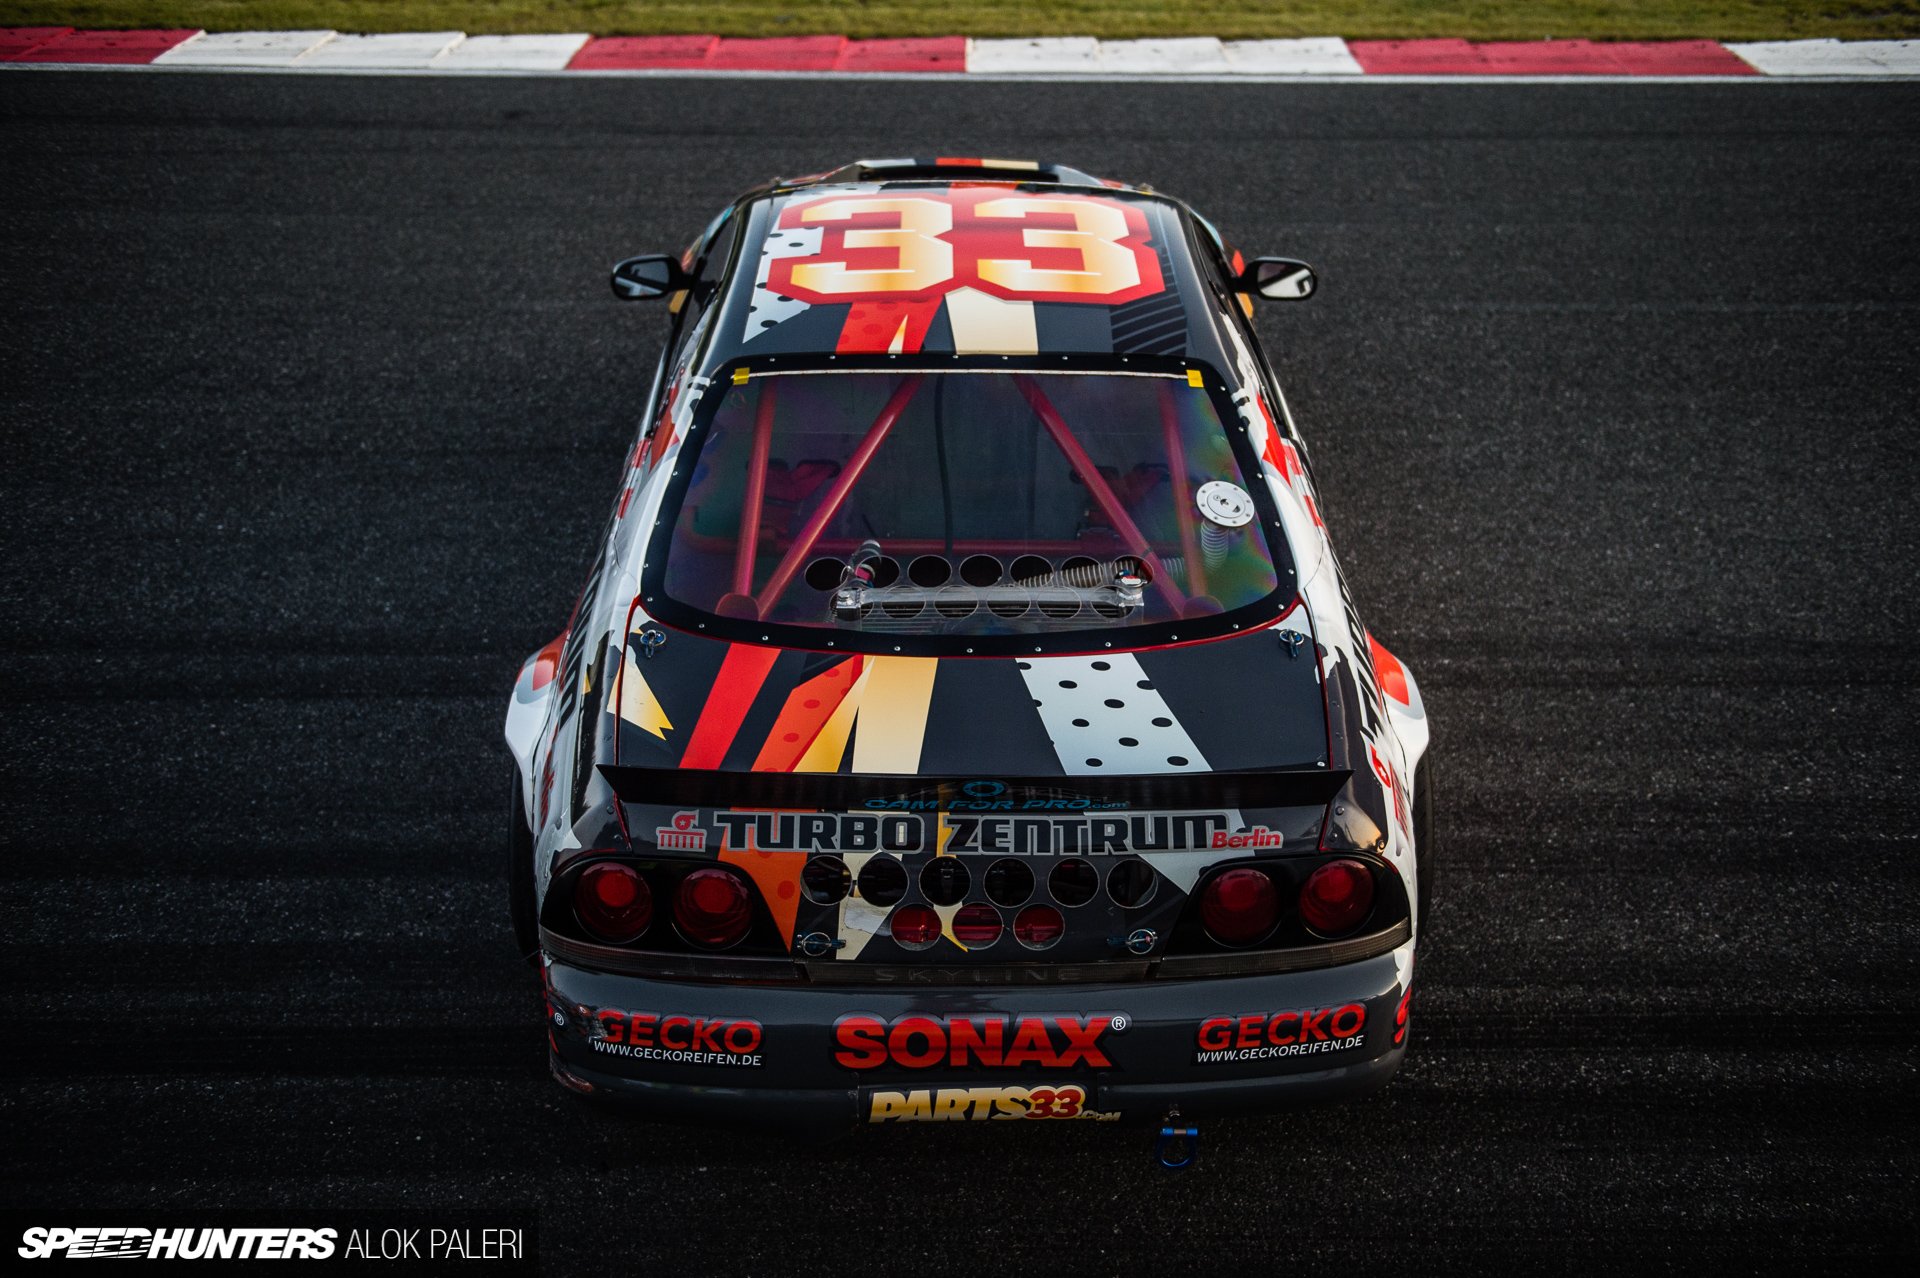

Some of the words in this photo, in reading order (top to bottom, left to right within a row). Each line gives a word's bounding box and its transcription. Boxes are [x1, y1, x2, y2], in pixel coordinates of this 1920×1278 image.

[785, 195, 1148, 298] 33
[864, 799, 938, 810] CAM
[948, 799, 1012, 810] FOR
[714, 811, 925, 855] TURBO
[944, 812, 1230, 855] ZENTRUM
[1211, 826, 1281, 850] Berlin
[597, 1009, 763, 1054] GECKO
[1197, 1035, 1364, 1063] WWW.GECKOREIFEN.DE
[1198, 1004, 1366, 1051] GECKO
[594, 1040, 762, 1066] WWW.GECKOREIFEN.DE
